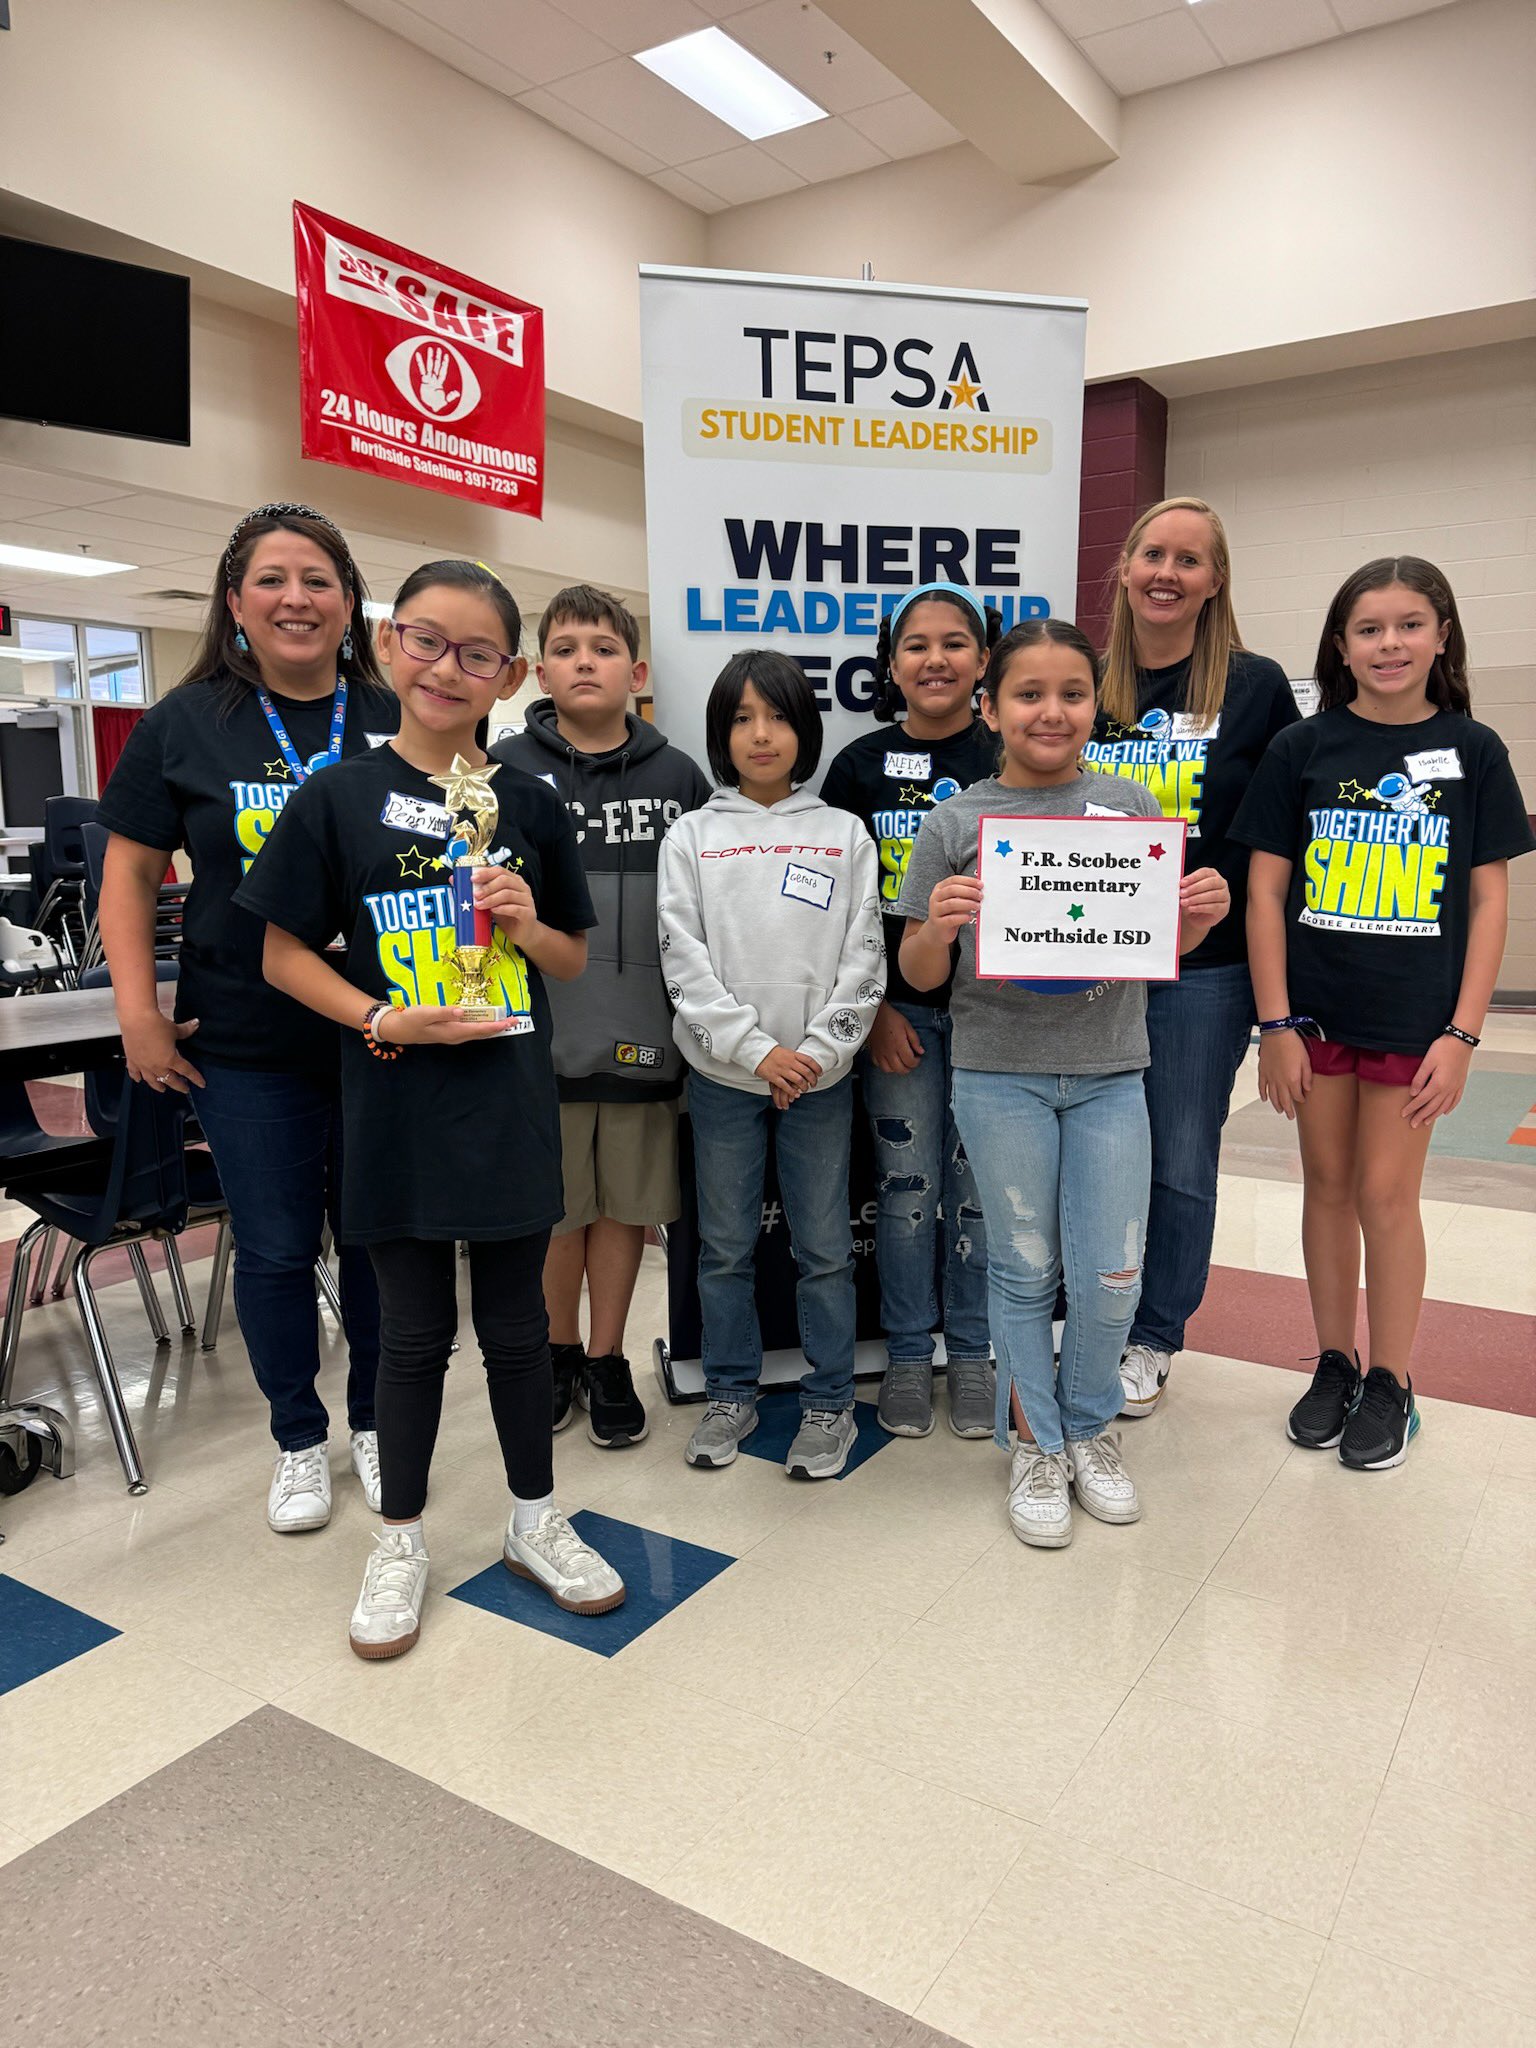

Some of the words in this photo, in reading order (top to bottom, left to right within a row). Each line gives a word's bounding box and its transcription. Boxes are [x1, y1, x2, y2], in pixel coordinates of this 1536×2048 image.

[338, 248, 390, 288] 397
[395, 275, 515, 357] SAFE
[743, 327, 991, 413] TEPSA
[320, 389, 352, 422] 24
[354, 399, 418, 444] Hours
[420, 423, 538, 477] Anonymous
[699, 408, 845, 446] STUDENT
[853, 418, 1039, 455] LEADERSHIP
[351, 435, 412, 469] Northside
[413, 455, 464, 484] Safeline
[464, 470, 519, 496] 397-7233
[723, 518, 1021, 587] WHERE
[686, 587, 1051, 636] LEADEIP
[334, 713, 344, 724] GT
[275, 729, 287, 740] GT
[331, 743, 341, 754] GT
[1080, 740, 1171, 762] OGETHER
[1175, 739, 1208, 761] WE
[291, 762, 303, 773] GT
[1308, 809, 1413, 845] TOGETHER
[1419, 814, 1451, 848] WE
[700, 844, 844, 859] CORVETTE
[1021, 851, 1063, 868] F.R.
[1068, 853, 1142, 870] Scobee
[1019, 876, 1142, 897] Elementary
[1304, 837, 1450, 921] SHINE
[365, 887, 456, 933] TOGET
[1301, 913, 1343, 928] SCOBEE
[1350, 921, 1436, 934] ELEMENTARY
[1004, 927, 1109, 945] Northside
[1112, 930, 1152, 945] ISD
[638, 1050, 656, 1065] 82
